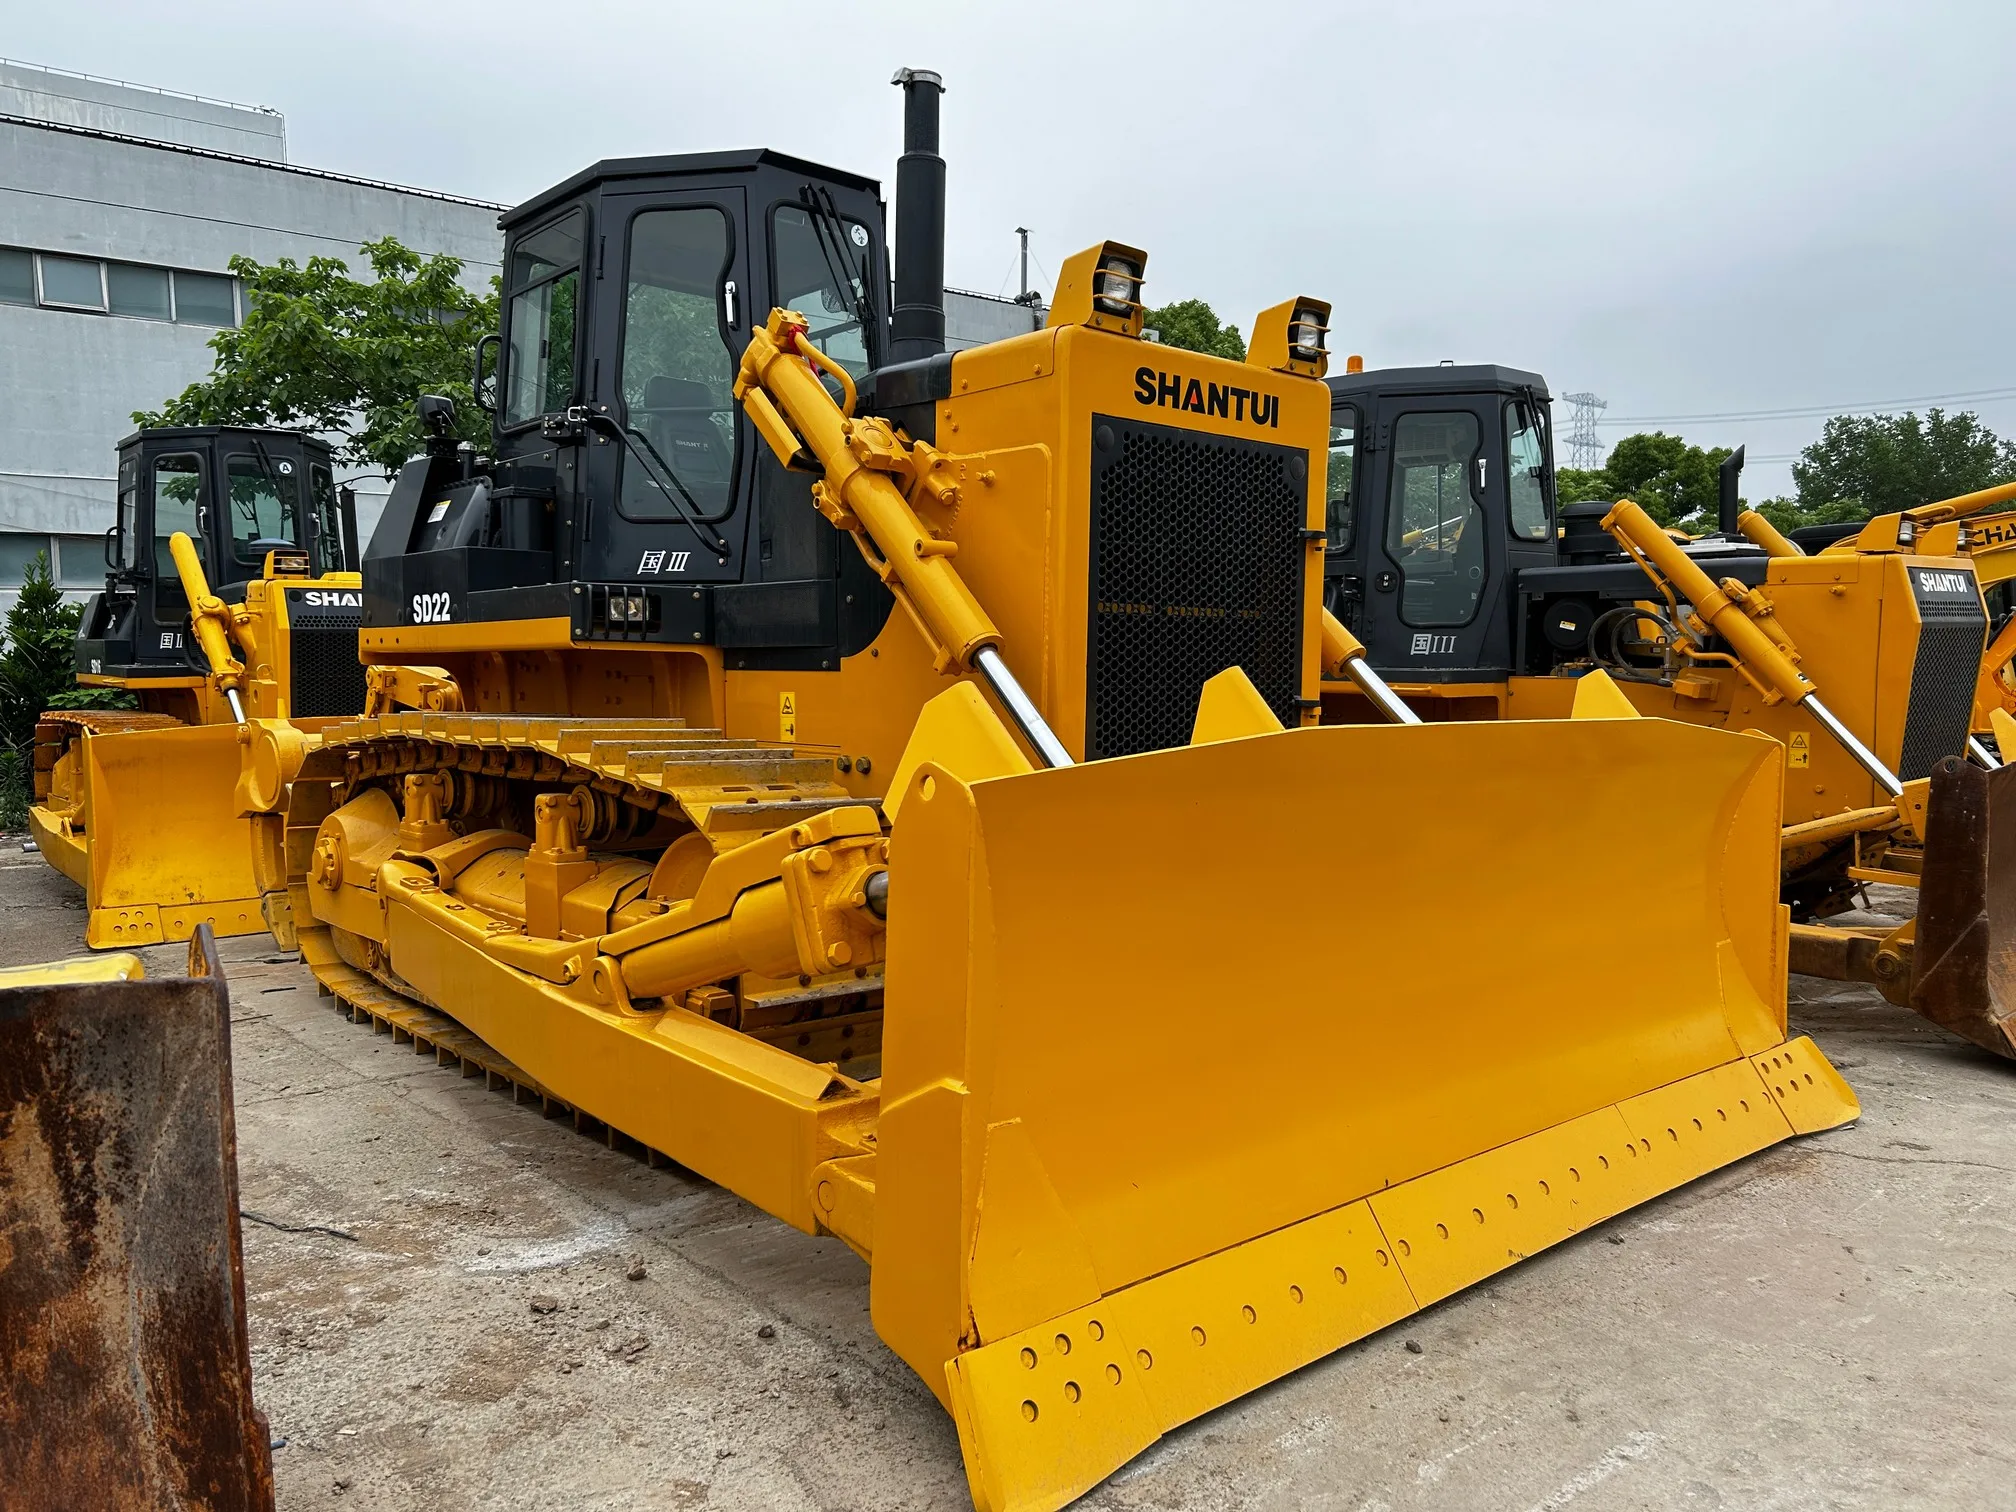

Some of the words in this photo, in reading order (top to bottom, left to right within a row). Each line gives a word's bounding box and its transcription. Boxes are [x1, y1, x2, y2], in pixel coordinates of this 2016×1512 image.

[1134, 366, 1279, 429] SHANTUI
[1920, 572, 1968, 593] SHANTUI
[305, 591, 362, 607] SHA
[412, 591, 451, 624] SD22
